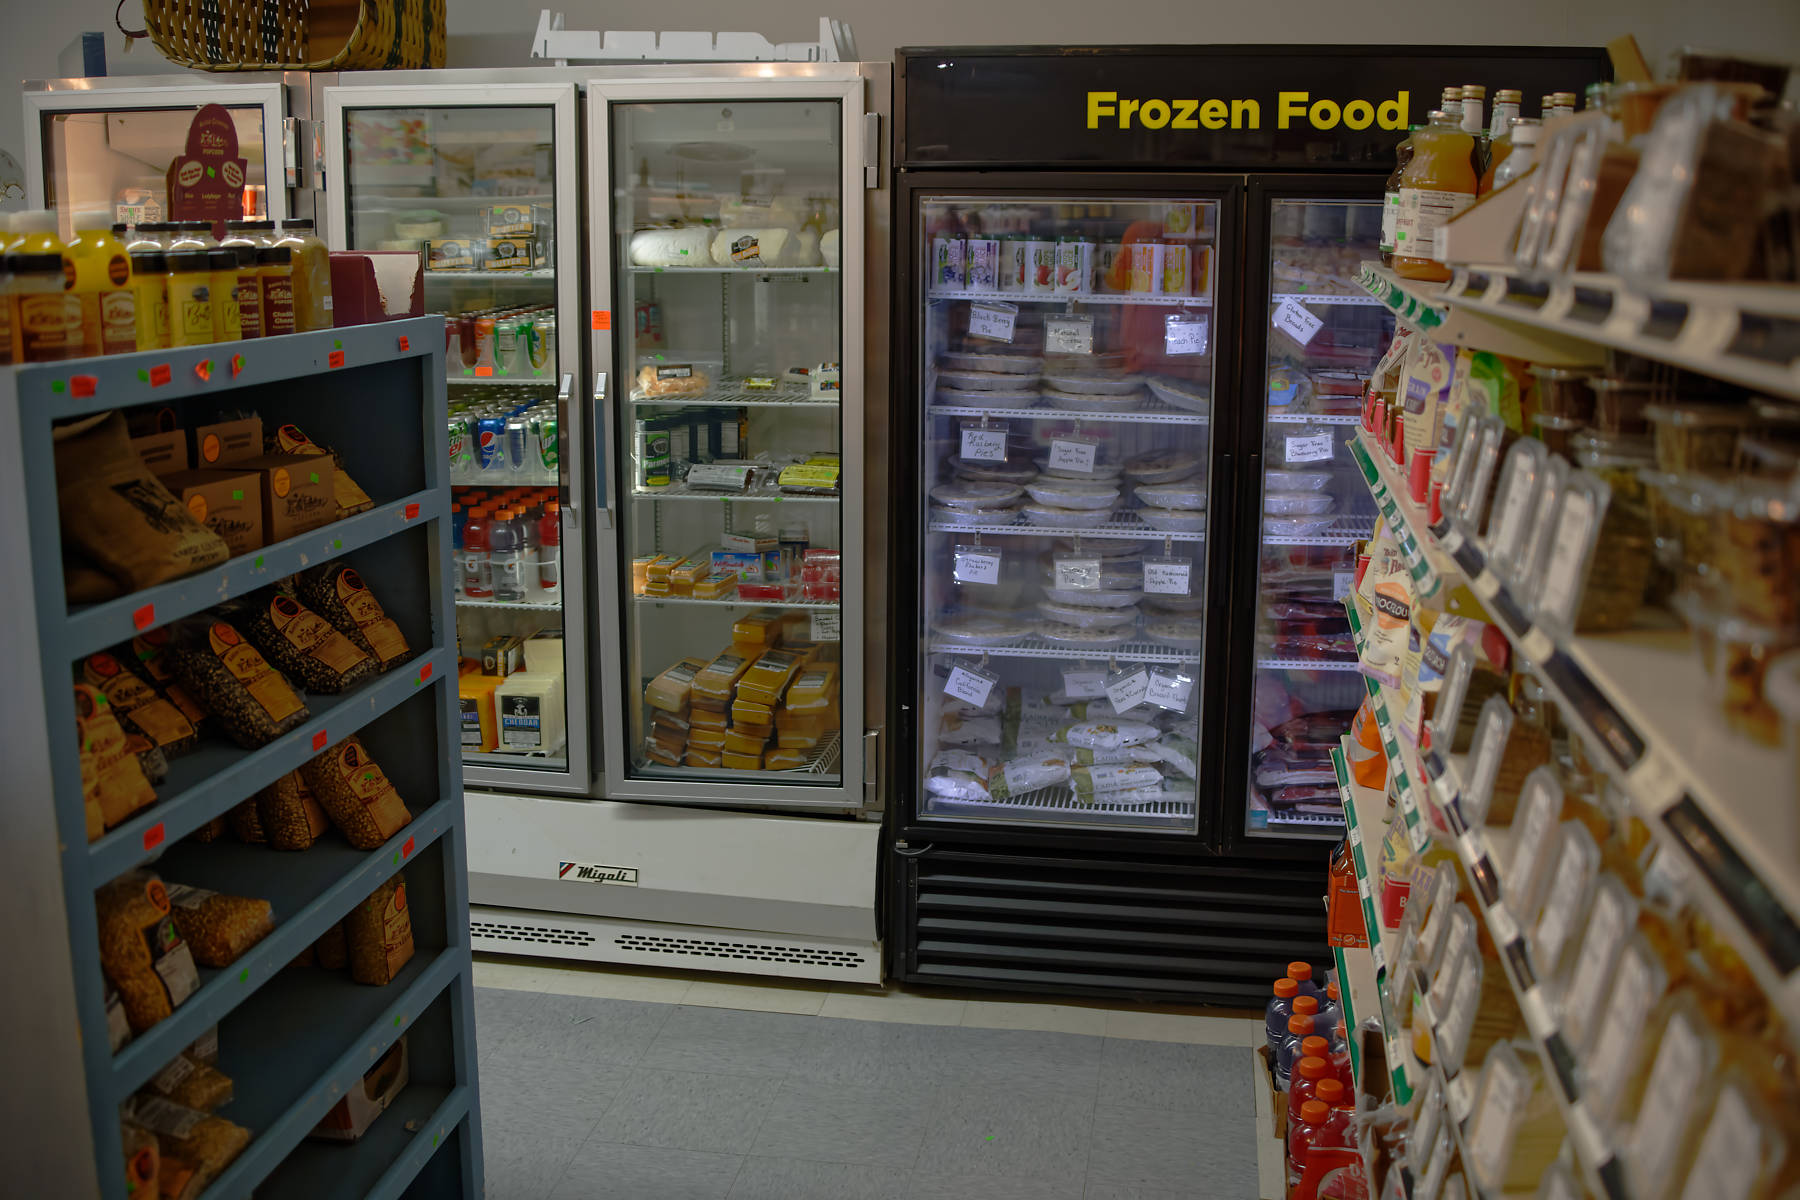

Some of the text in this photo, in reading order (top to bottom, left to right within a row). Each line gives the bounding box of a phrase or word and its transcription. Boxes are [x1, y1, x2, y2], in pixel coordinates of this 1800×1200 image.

[1087, 91, 1410, 130] Frozen Food
[492, 258, 522, 266] BUTTER
[504, 717, 539, 727] CHEDDAR
[577, 866, 628, 883] Migali
